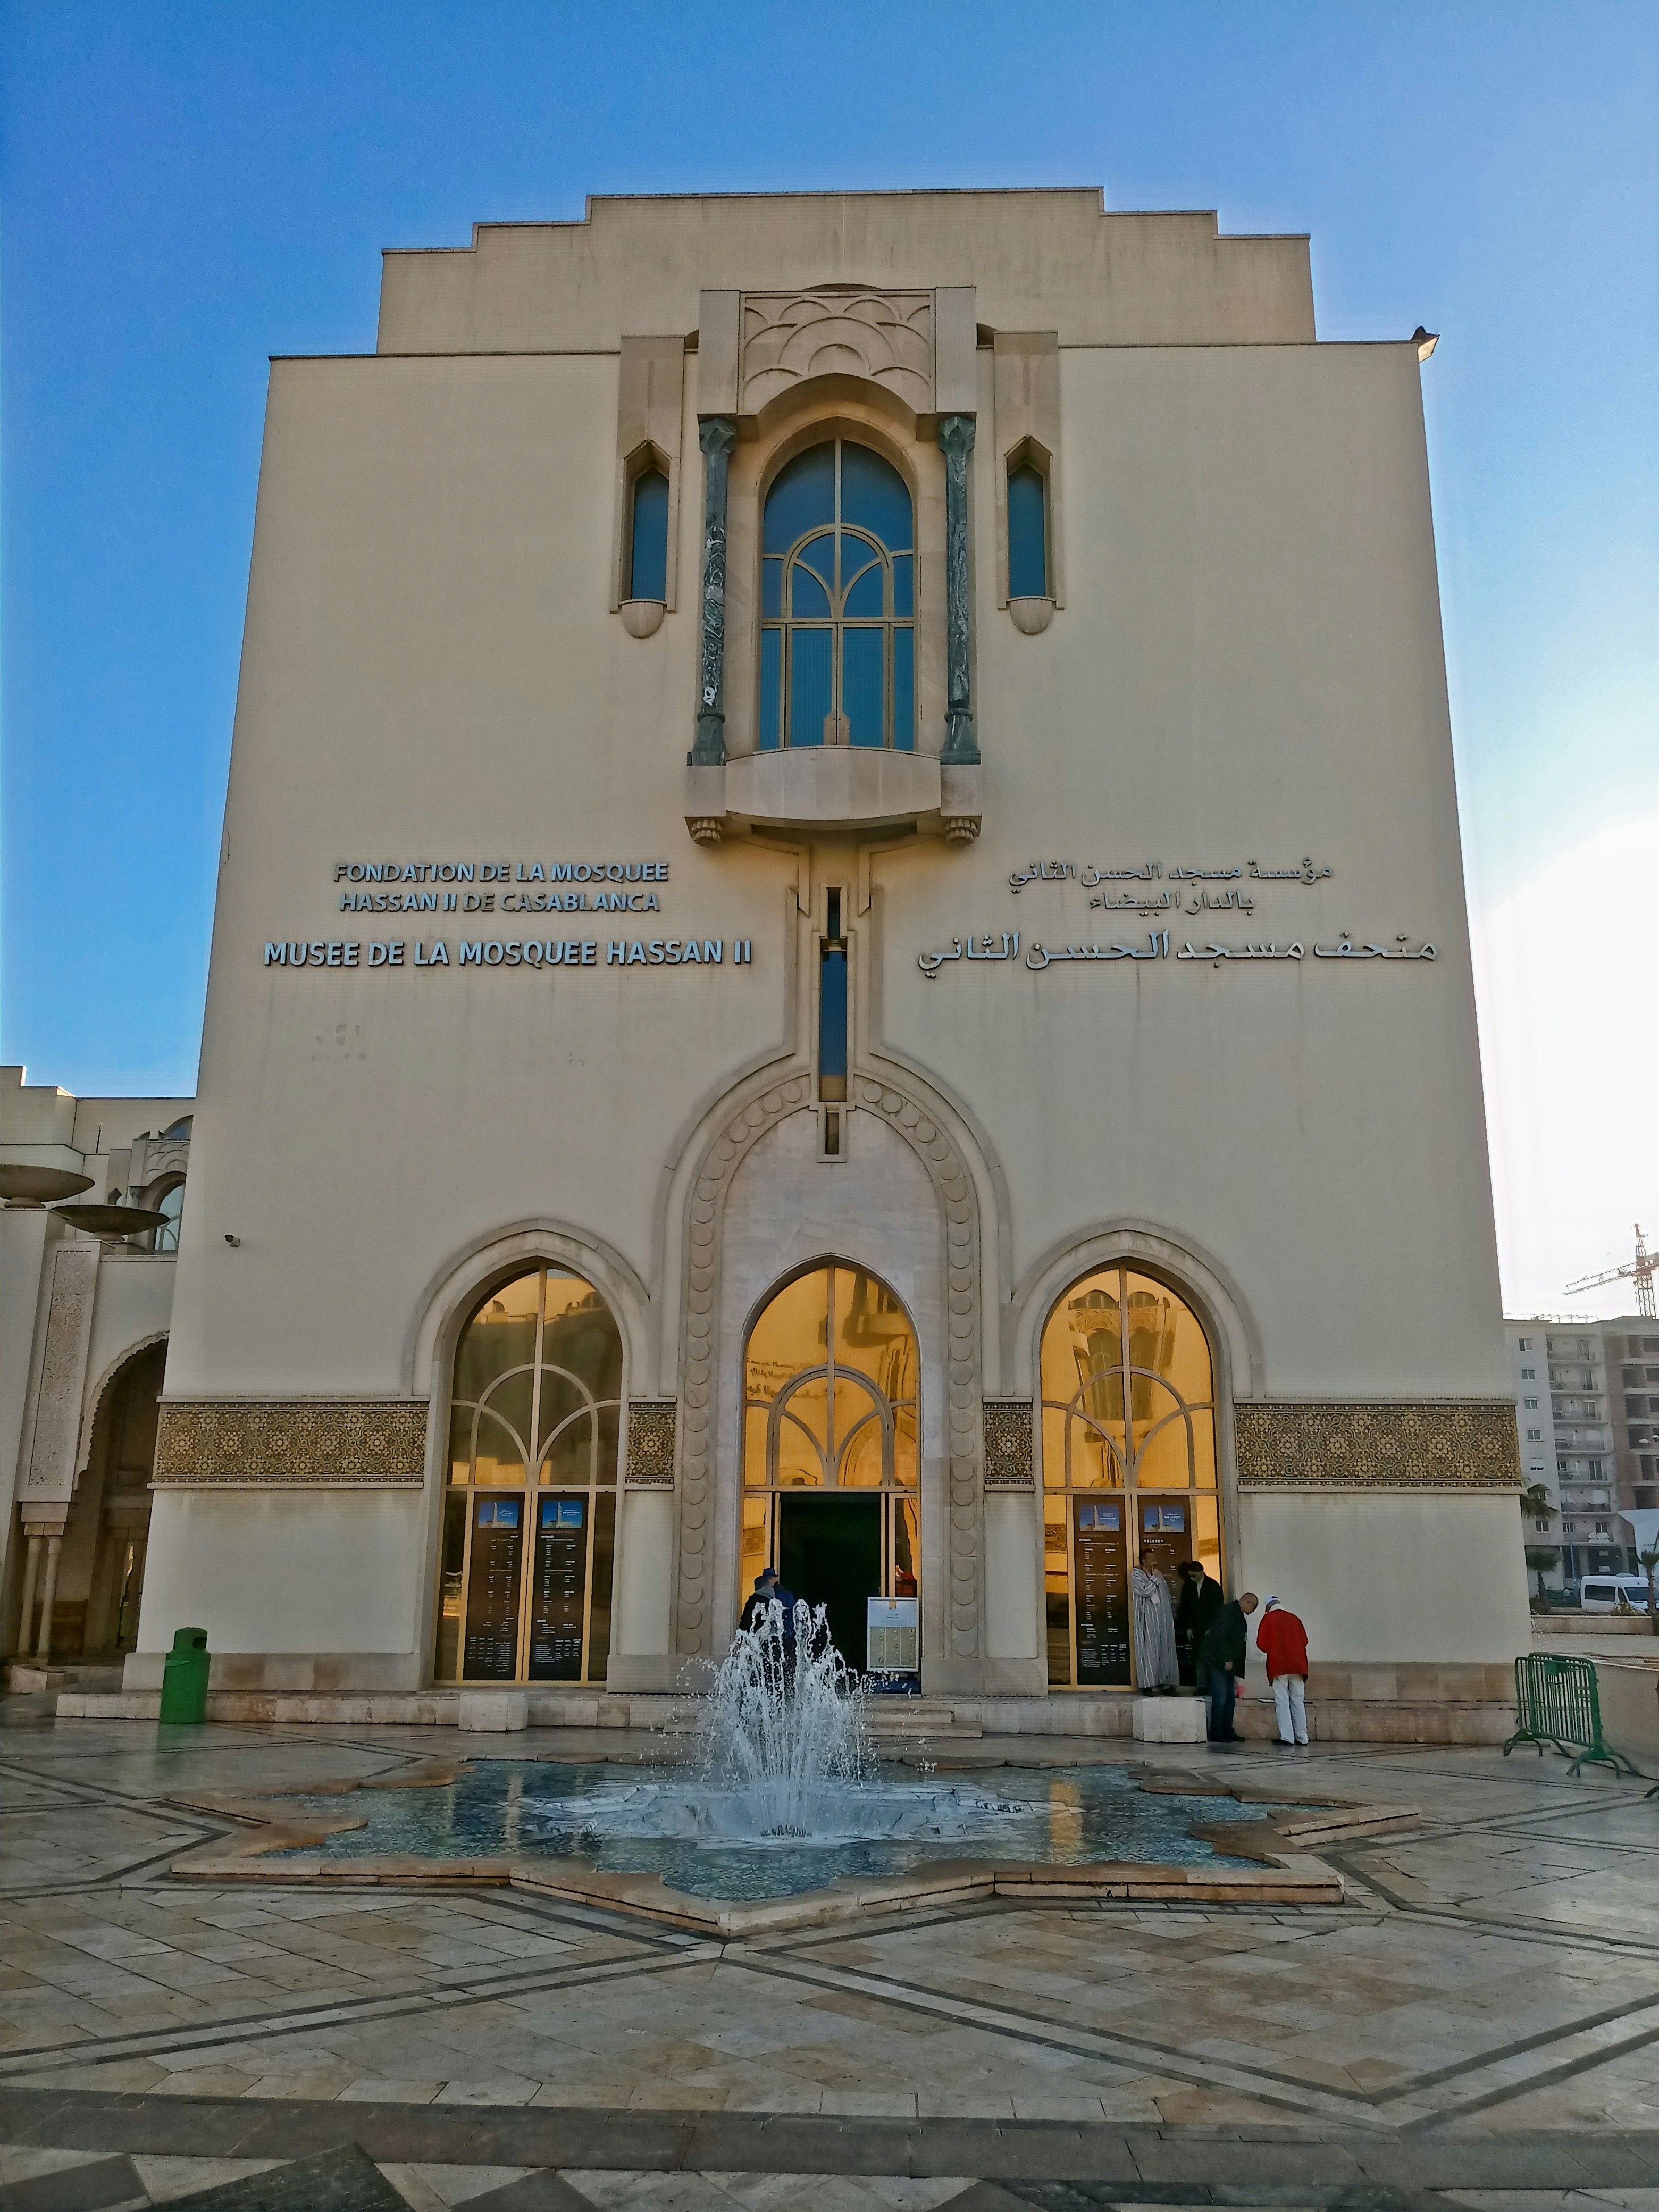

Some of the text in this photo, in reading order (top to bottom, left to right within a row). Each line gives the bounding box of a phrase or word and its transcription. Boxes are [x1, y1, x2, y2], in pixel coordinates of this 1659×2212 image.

[333, 862, 669, 884] FONDATION DE LA MOSQUEE
[1009, 857, 1333, 894] مؤسسة مسجد الحسن الثاني
[340, 892, 661, 912] HASSAN II DE CASABLANCA
[1089, 890, 1254, 917] بالدار البيضاء
[263, 939, 752, 969] MUSEE DE LA MOSQUEE HASSAN II
[918, 929, 1439, 979] متحف مسجد الحسن الثاني
